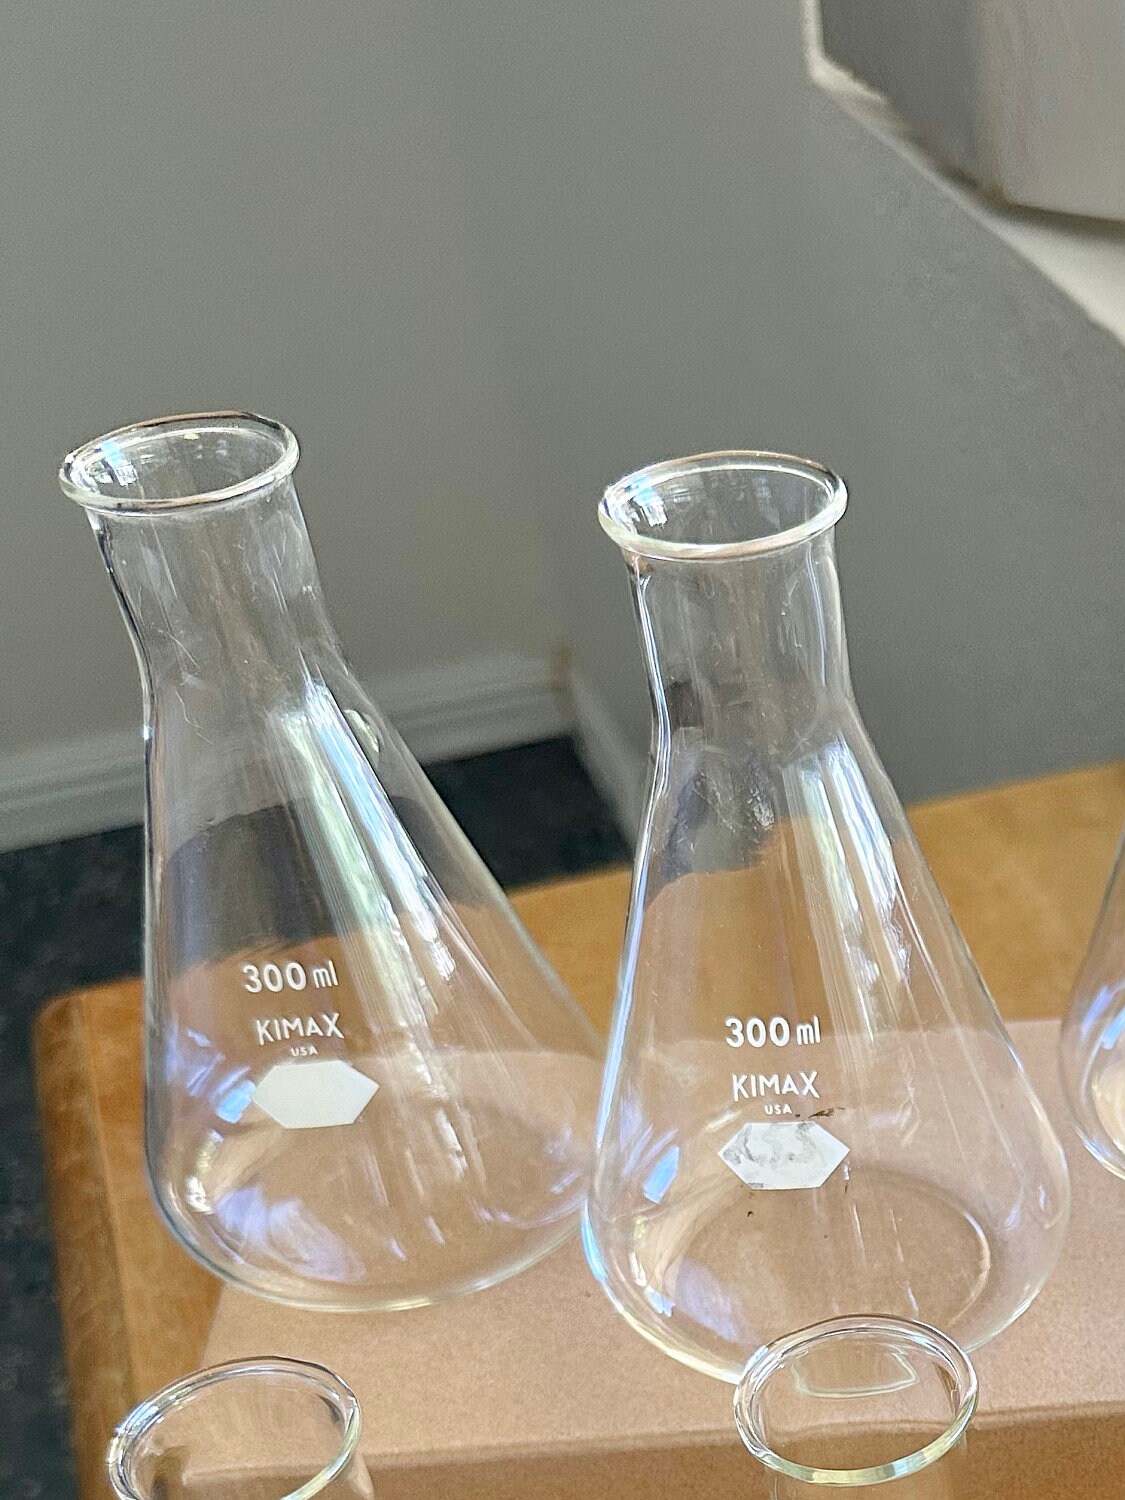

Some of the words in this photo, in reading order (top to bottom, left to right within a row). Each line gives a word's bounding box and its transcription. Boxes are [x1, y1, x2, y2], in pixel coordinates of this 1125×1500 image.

[242, 961, 307, 993] 300
[312, 959, 339, 989] ml
[256, 1013, 344, 1046] KIMAX
[725, 1016, 790, 1048] 300
[796, 1015, 821, 1046] ml
[291, 1046, 319, 1057] USA
[732, 1070, 821, 1102] KIMAX
[764, 1103, 793, 1115] USA
